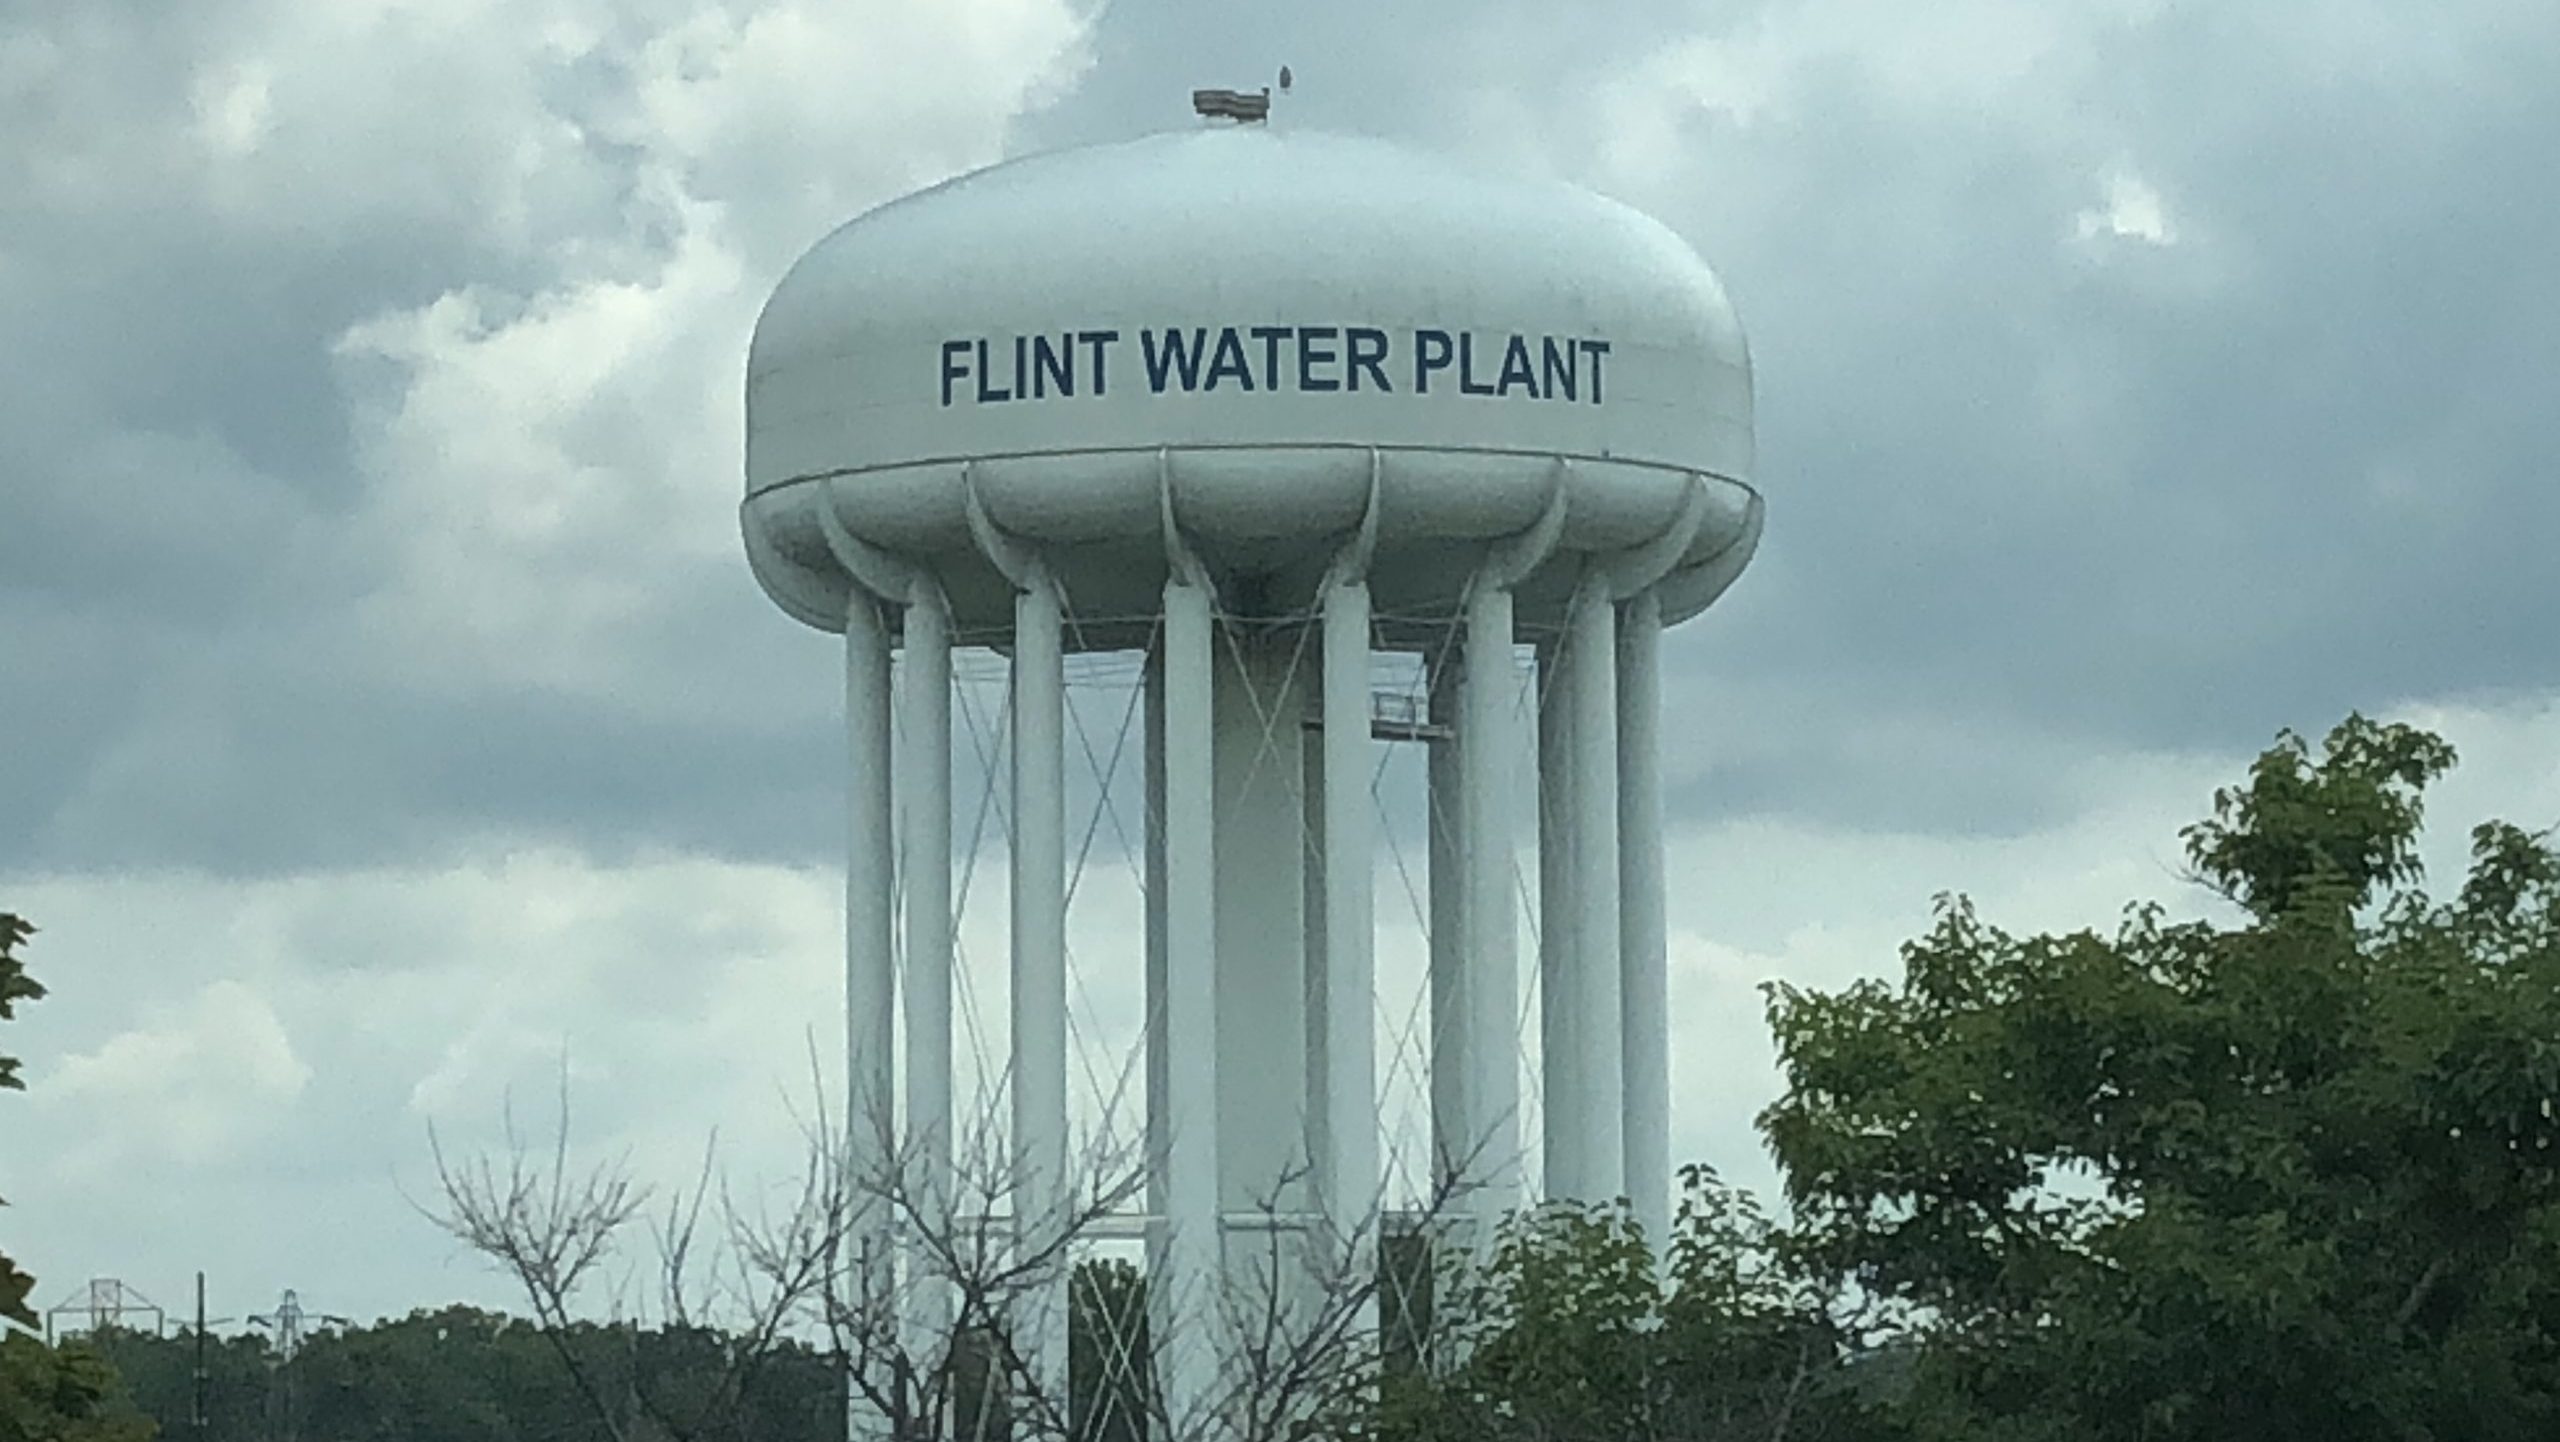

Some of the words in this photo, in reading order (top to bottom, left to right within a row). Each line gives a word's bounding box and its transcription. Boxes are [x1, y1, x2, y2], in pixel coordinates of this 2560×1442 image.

[941, 331, 1118, 406] FLINT
[1140, 326, 1393, 393] WATER
[1415, 329, 1611, 404] PLANT
